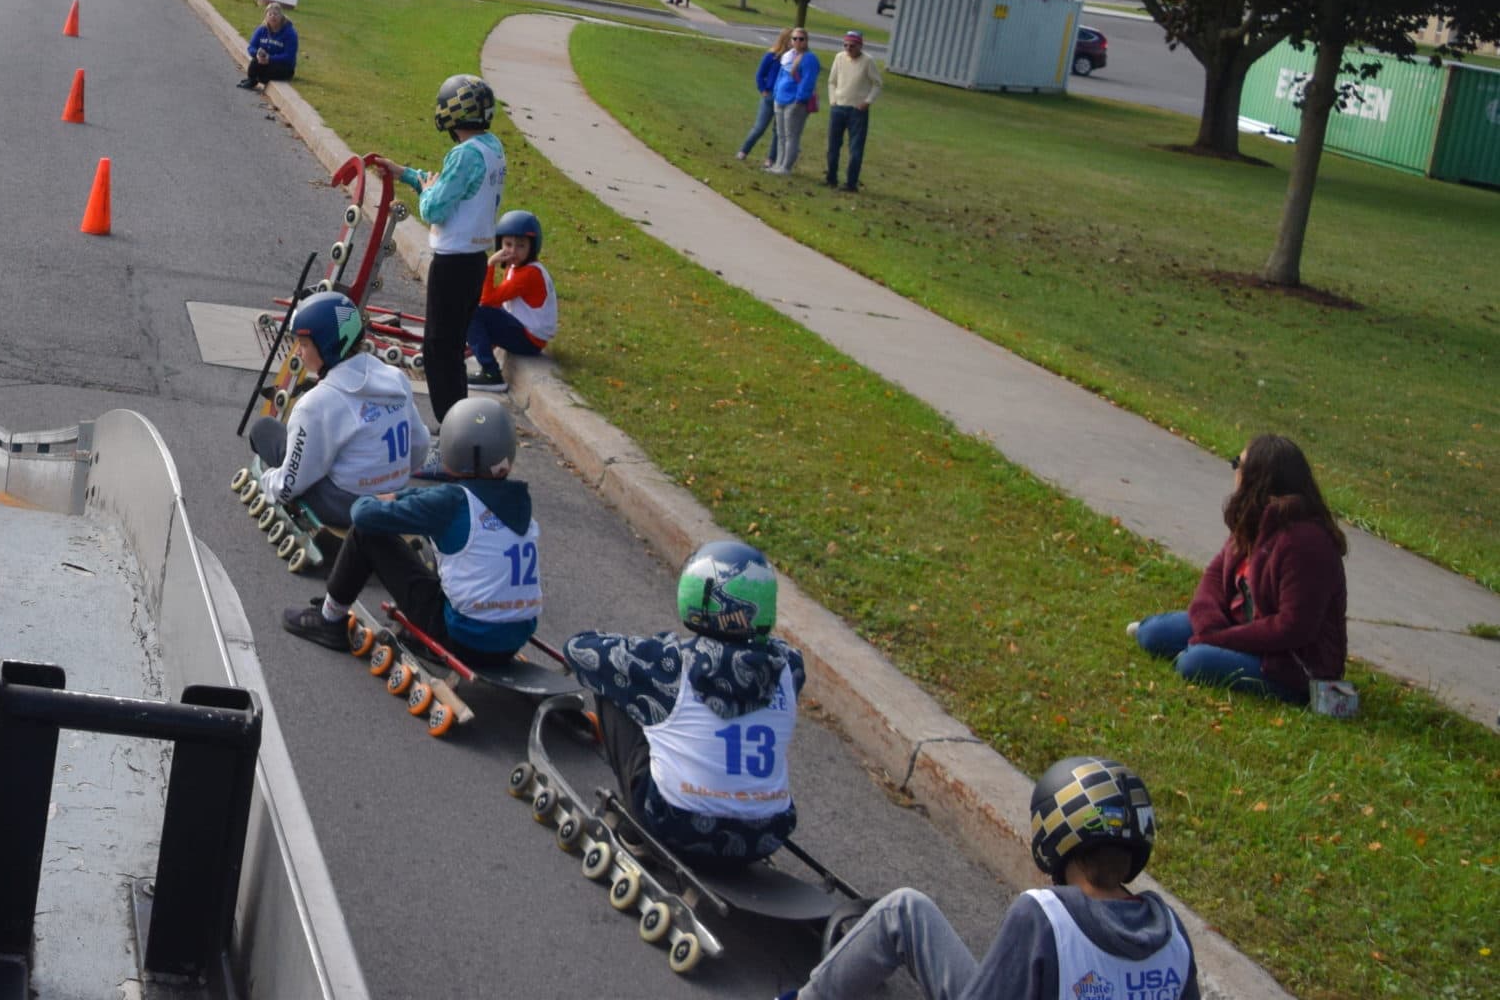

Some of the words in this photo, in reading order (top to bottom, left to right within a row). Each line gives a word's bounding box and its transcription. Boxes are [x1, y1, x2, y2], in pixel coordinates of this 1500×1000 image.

[381, 420, 409, 464] 10
[503, 541, 538, 587] 12
[715, 724, 776, 779] 13
[1126, 966, 1181, 991] USA
